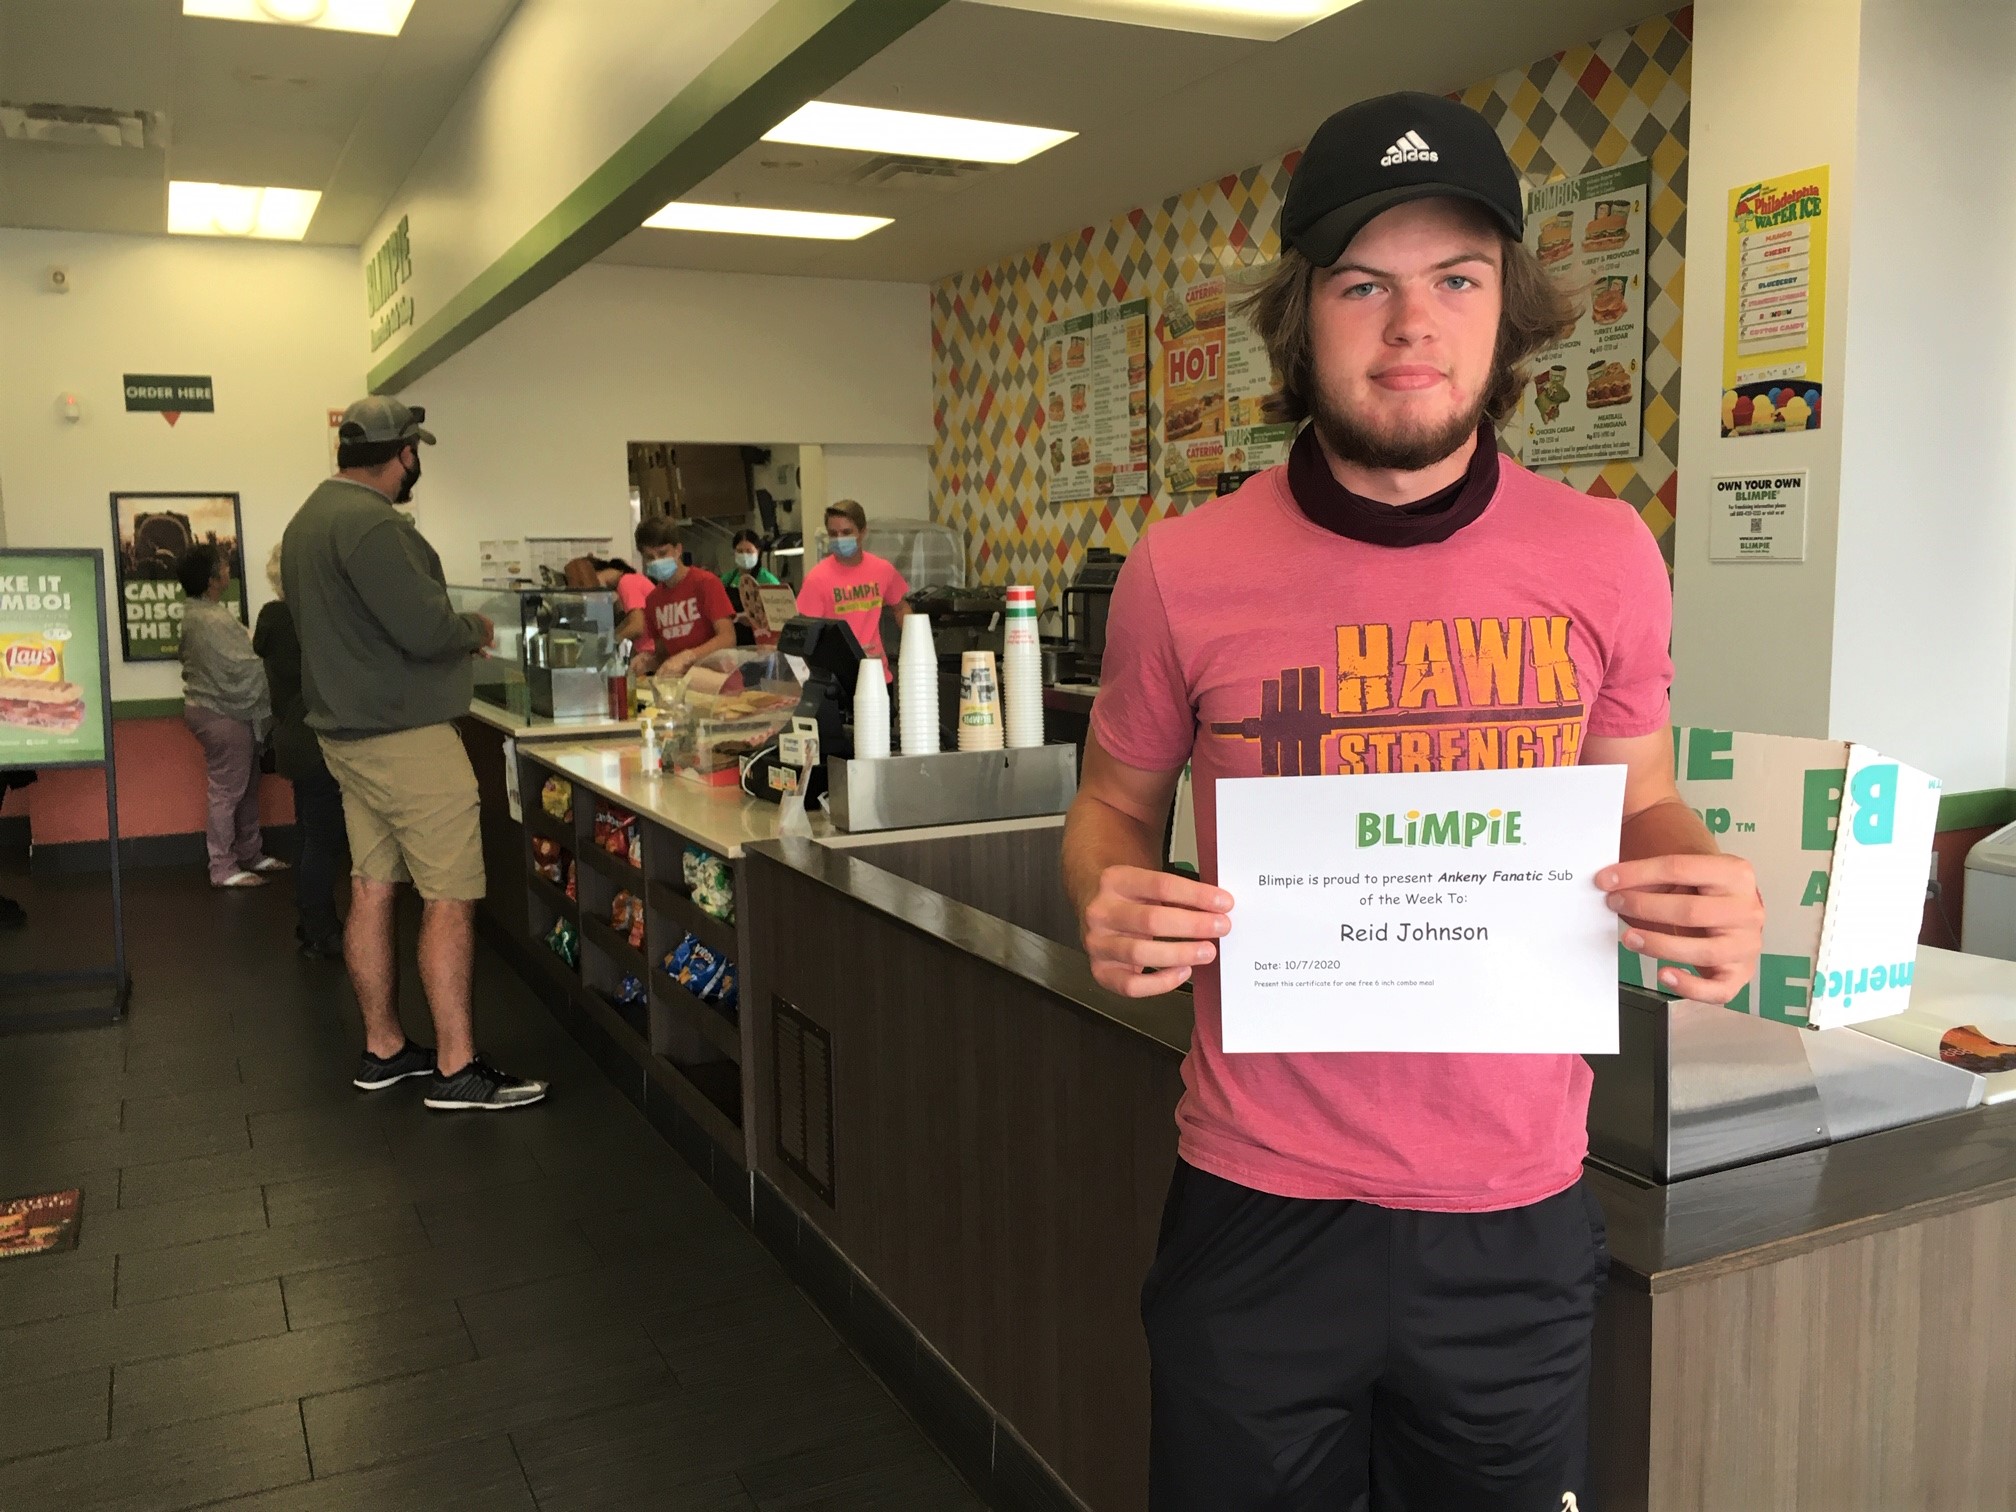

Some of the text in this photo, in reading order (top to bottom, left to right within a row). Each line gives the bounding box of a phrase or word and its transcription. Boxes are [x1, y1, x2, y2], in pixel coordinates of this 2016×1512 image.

[1380, 149, 1439, 167] adidas
[1532, 180, 1581, 213] COMBOS
[1754, 185, 1820, 215] Philadelphia
[1754, 196, 1822, 229] WATER ICE
[1168, 342, 1221, 386] HOT
[126, 386, 212, 399] ORDER HERE
[1186, 444, 1224, 459] CATERING
[1717, 478, 1802, 491] OWN YOUR OWN
[1740, 542, 1770, 550] BLIMPIE
[0, 574, 62, 593] KE IT
[124, 582, 183, 600] CAN'
[0, 593, 71, 611] MBO!
[655, 597, 701, 629] NIKE
[127, 621, 172, 640] THE
[1334, 615, 1582, 715] HAWK
[1258, 869, 1574, 889] Blimpie is proud to present Ankeny Fanatic Sub
[1359, 892, 1468, 906] of the Week To:
[1340, 921, 1489, 942] Reid Johnson
[1254, 960, 1341, 971] Date: 10/7/2020
[1295, 979, 1331, 987] certificate
[1333, 979, 1343, 988] for
[1358, 979, 1373, 987] free
[1374, 979, 1380, 987] 6
[1381, 979, 1395, 987] inch
